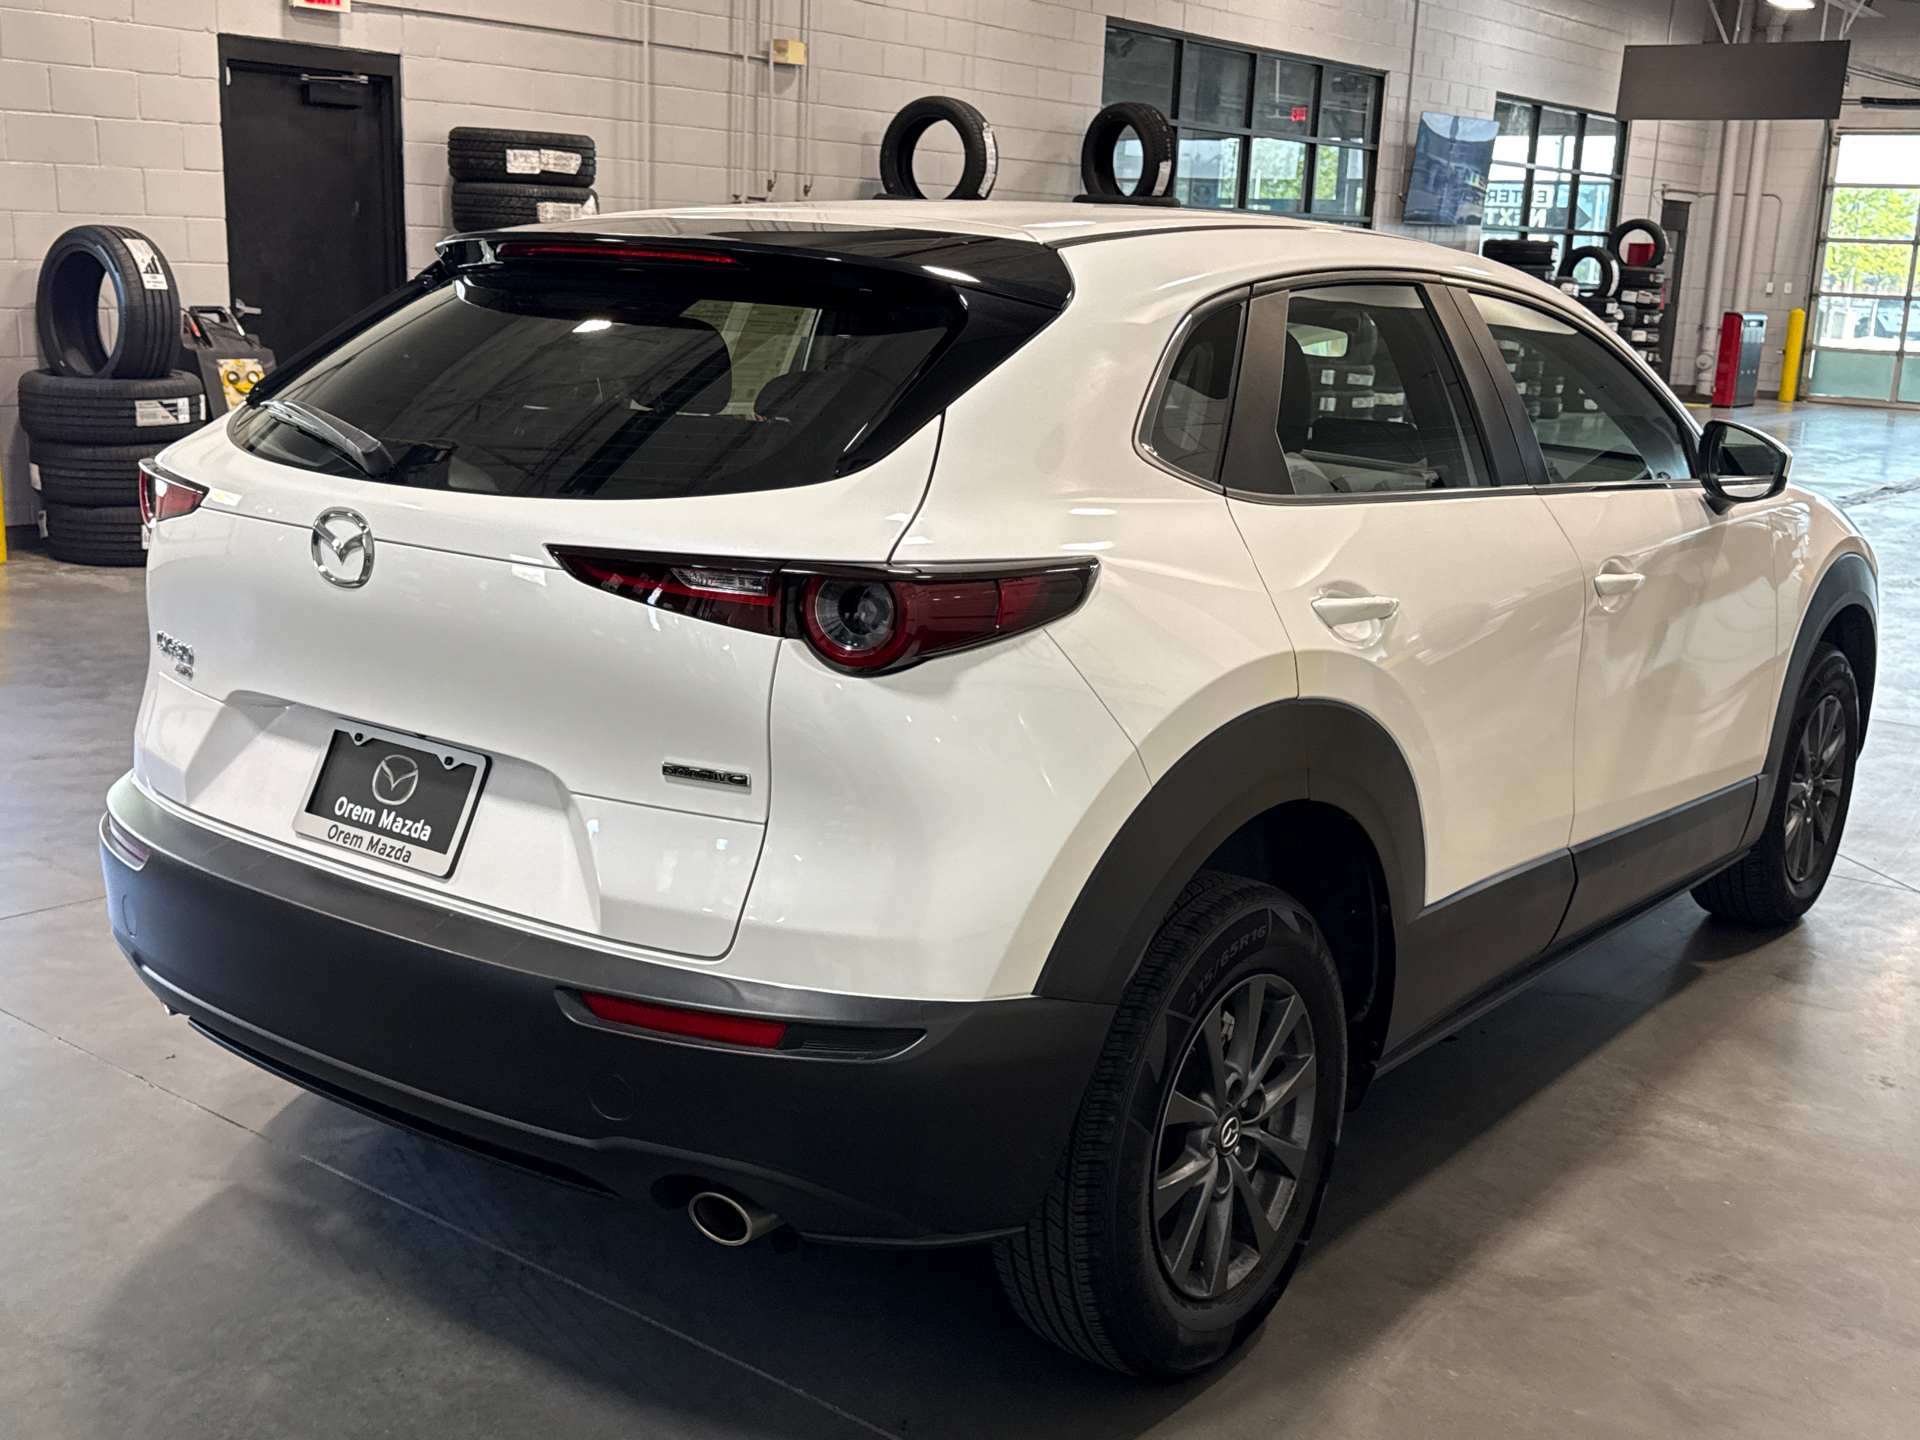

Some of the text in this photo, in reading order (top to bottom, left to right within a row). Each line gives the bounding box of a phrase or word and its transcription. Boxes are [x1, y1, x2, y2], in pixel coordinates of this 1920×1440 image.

[334, 796, 432, 842] Orem Mazda
[327, 824, 412, 863] Orem Mazda
[1188, 925, 1267, 1014] 215/65R16
